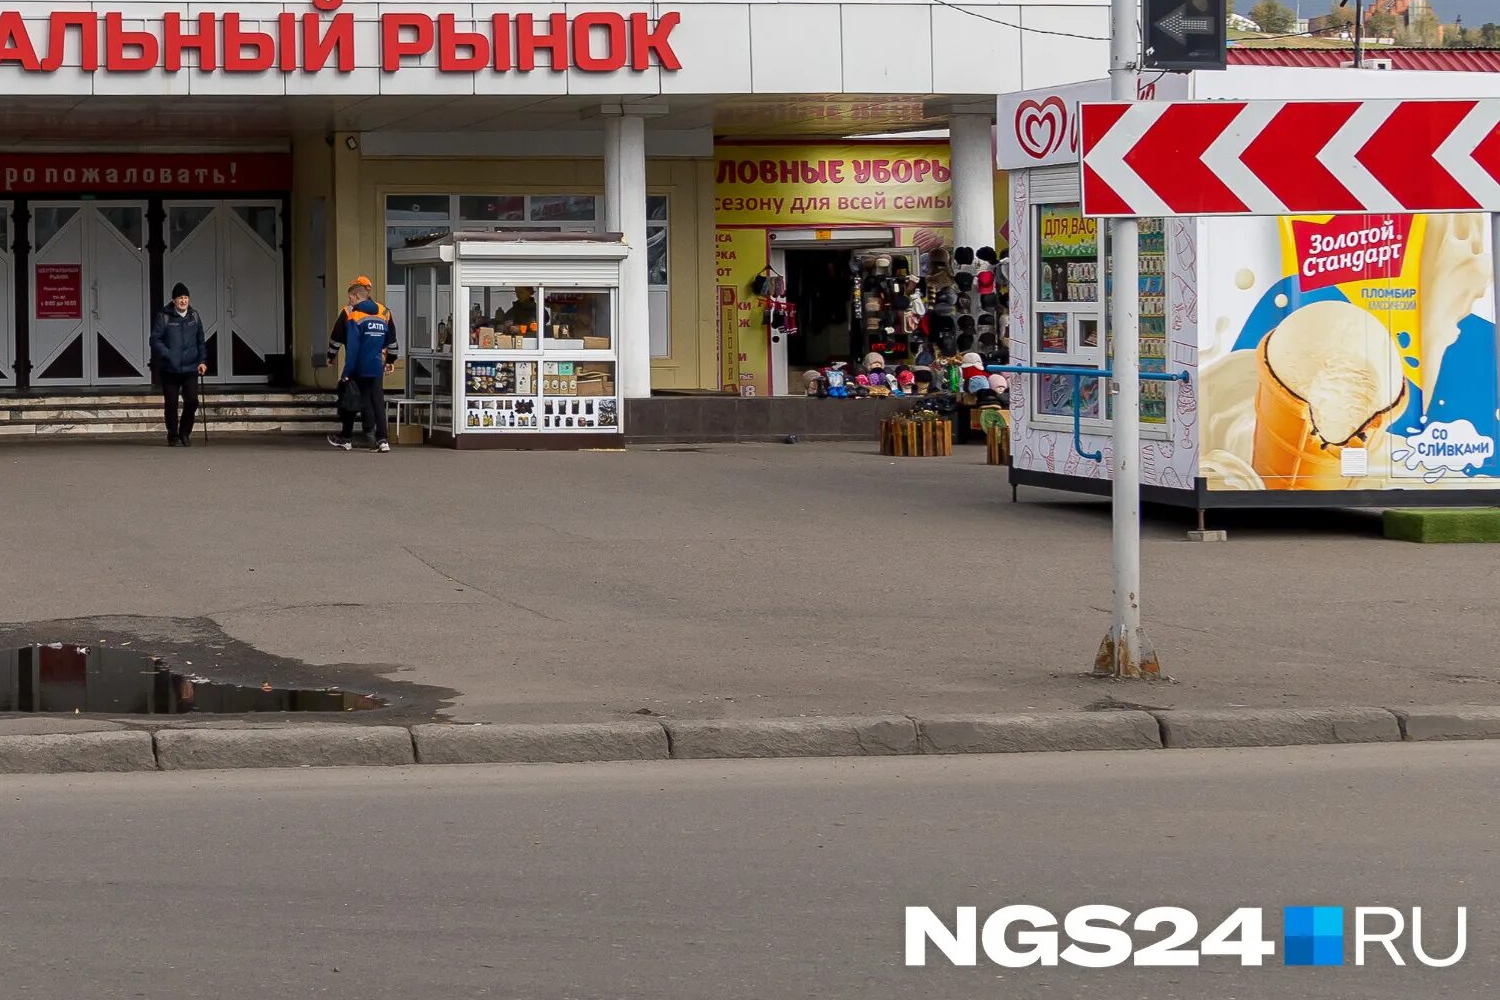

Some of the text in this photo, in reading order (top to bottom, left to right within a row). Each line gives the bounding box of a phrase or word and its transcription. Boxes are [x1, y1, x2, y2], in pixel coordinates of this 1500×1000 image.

[382, 11, 684, 71] РЫНОК
[45, 162, 237, 184] пожаловать!
[715, 158, 844, 185] ЛОВНЫЕ
[790, 195, 830, 214] для
[838, 191, 886, 211] всей
[1044, 218, 1068, 240] ДЛЯ
[1309, 220, 1395, 254] Золотой
[1303, 243, 1402, 277] Стандарт
[1361, 288, 1417, 298] ПЛОМБИР
[1432, 428, 1448, 441] СО
[1417, 442, 1490, 457] СЛИВКАМИ
